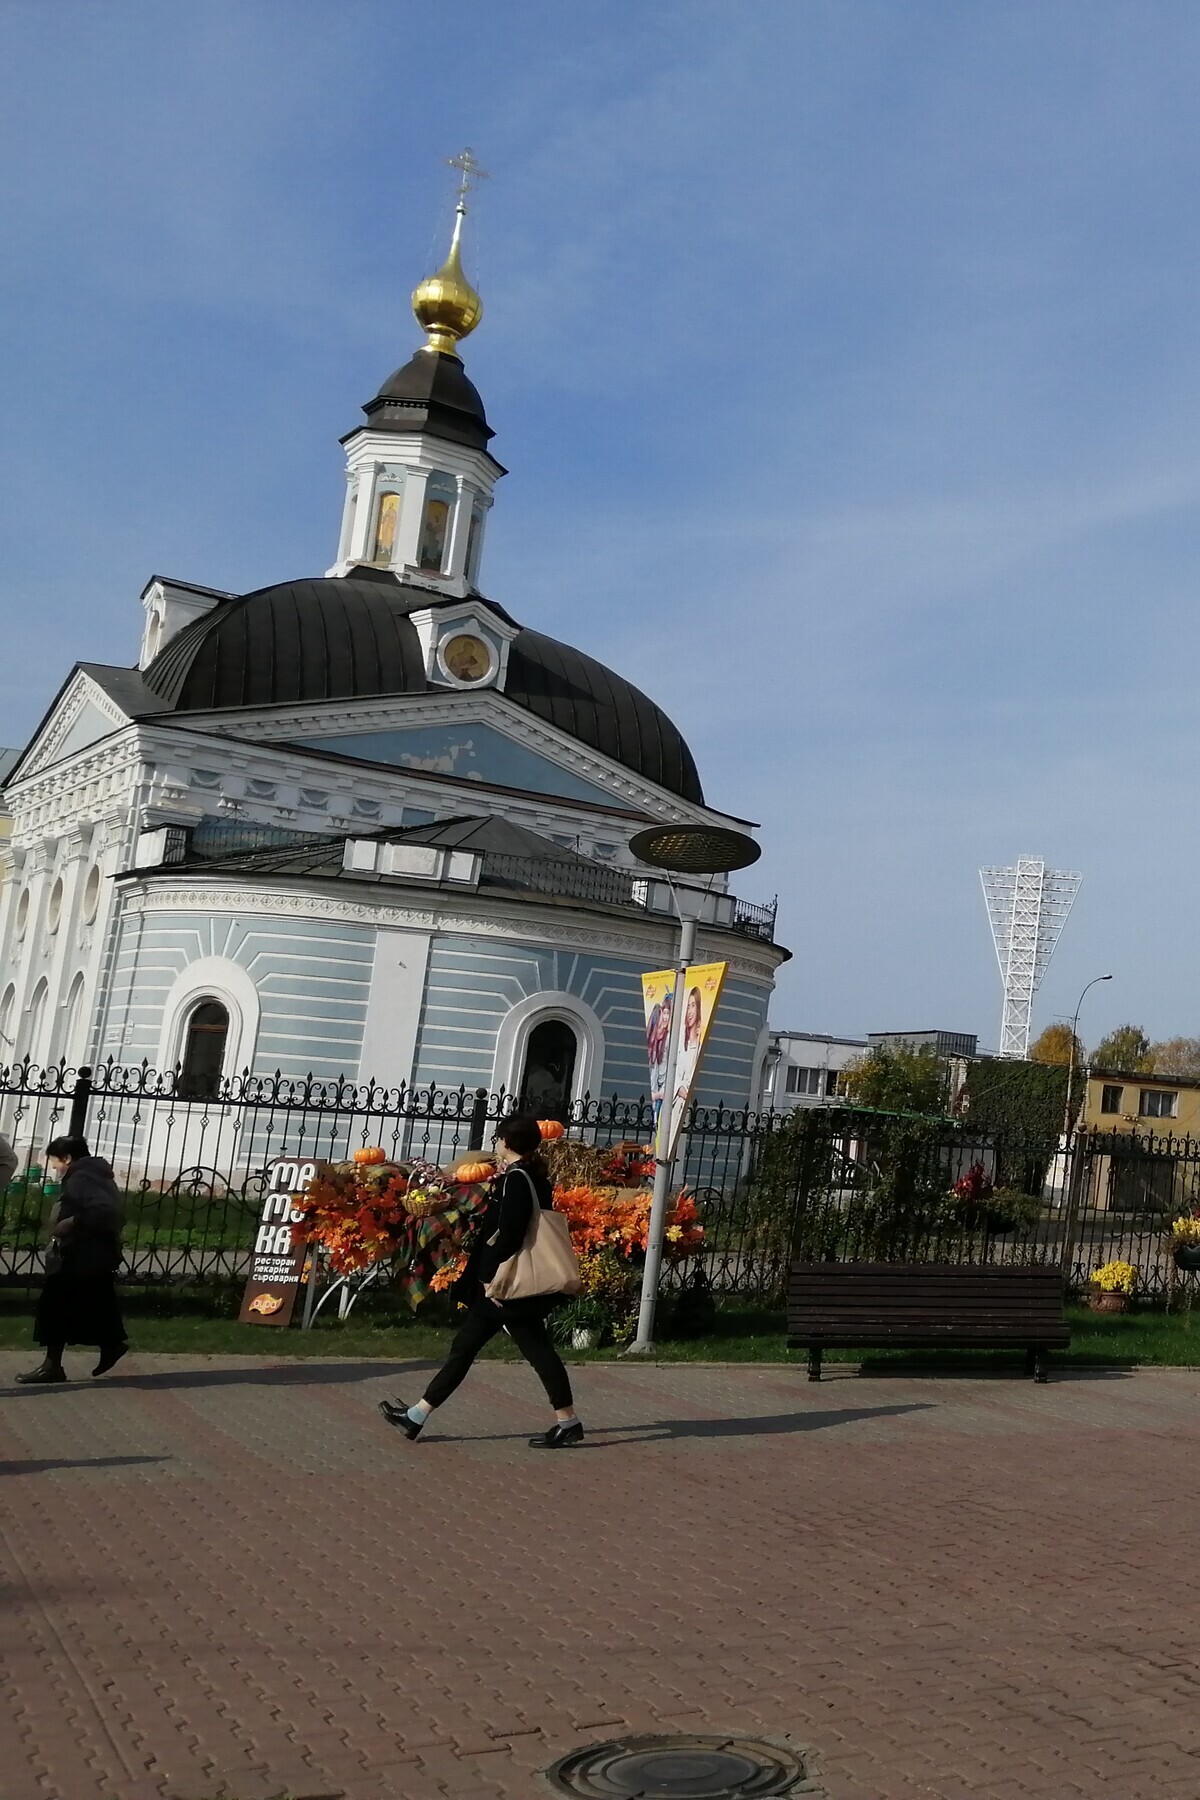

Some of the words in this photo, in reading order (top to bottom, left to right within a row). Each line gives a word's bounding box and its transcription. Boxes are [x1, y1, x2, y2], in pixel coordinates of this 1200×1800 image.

[254, 1257, 296, 1267] ресторан
[254, 1266, 290, 1275] пекарня
[252, 1274, 299, 1284] сыроварня
